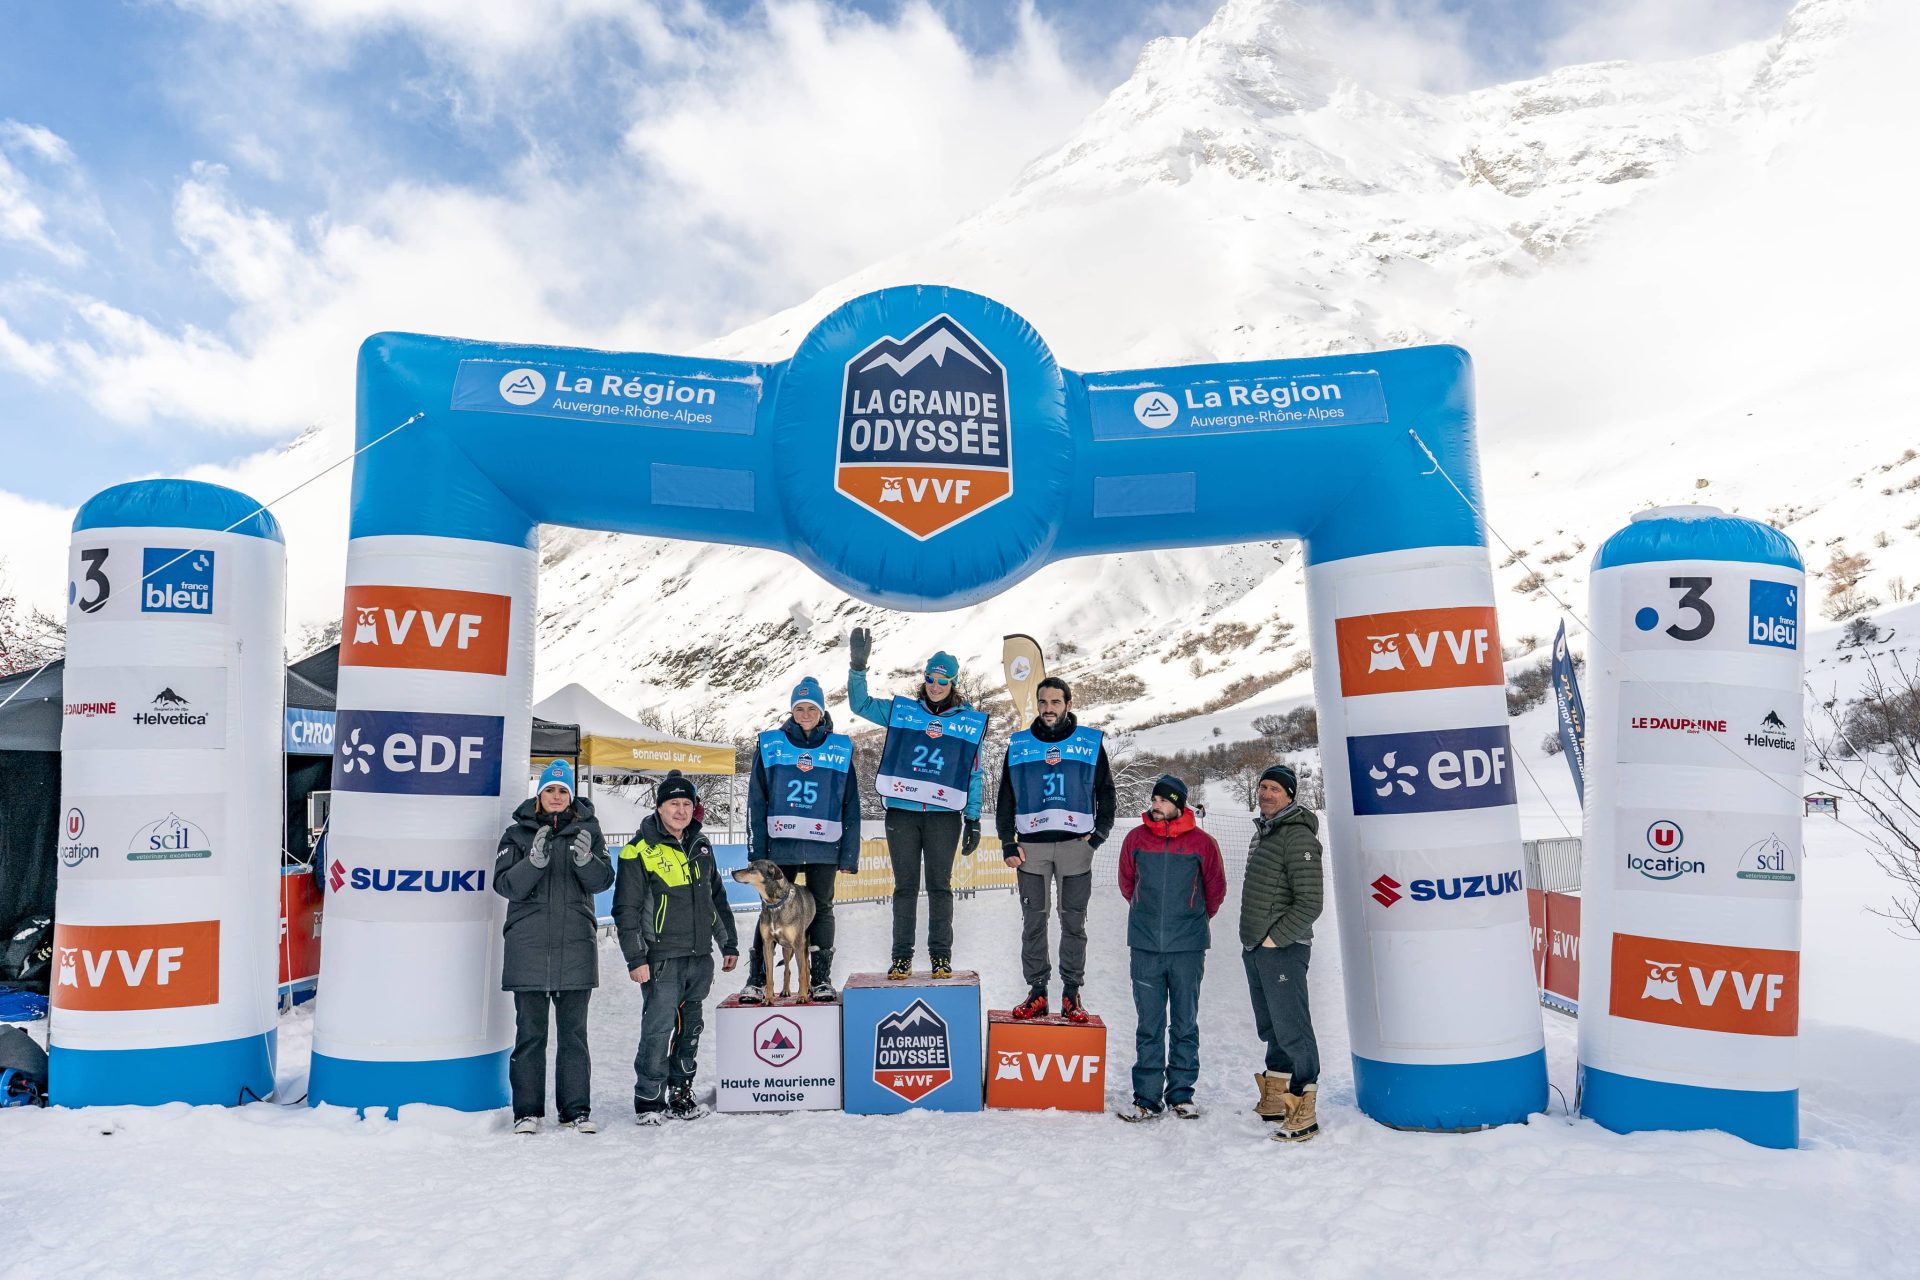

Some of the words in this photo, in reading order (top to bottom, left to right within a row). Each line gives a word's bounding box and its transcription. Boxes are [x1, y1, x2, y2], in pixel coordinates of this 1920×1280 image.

[555, 371, 592, 394] La
[602, 374, 716, 405] Région
[1185, 388, 1222, 409] La
[1229, 381, 1342, 409] Région
[553, 398, 712, 424] Auvergne-Rhône-Alpes
[852, 390, 884, 415] LA
[889, 389, 998, 418] GRANDE
[1190, 406, 1344, 428] Auvergne-Rhône-Alpes
[850, 417, 1000, 456] ODYSSÉE
[907, 477, 970, 504] VVF
[79, 548, 110, 613] 3
[181, 581, 209, 591] france
[146, 583, 208, 610] bleu
[1665, 577, 1715, 641] 3
[1779, 616, 1795, 626] france
[384, 608, 482, 650] VVF
[1753, 615, 1795, 645] bleu
[1406, 628, 1489, 668] VVF
[291, 720, 336, 744] CHRO
[958, 724, 977, 735] VVF
[1632, 717, 1648, 728] LE
[383, 733, 484, 774] eDF
[633, 748, 671, 761] Bonneval
[673, 753, 687, 762] sur
[688, 753, 702, 763] Arc
[827, 754, 845, 764] VVF
[912, 745, 944, 770] 24
[1075, 746, 1093, 756] VVF
[1428, 747, 1506, 790] eDF
[787, 780, 818, 804] 25
[1042, 773, 1064, 796] 31
[69, 817, 79, 833] U
[150, 828, 190, 850] scil
[1655, 829, 1674, 846] U
[60, 843, 99, 858] ocation
[1757, 849, 1785, 871] scil
[1627, 854, 1705, 873] location
[351, 867, 486, 893] SUZUKI
[1409, 869, 1523, 901] SUZUKI
[1562, 932, 1580, 961] VV
[82, 947, 184, 987] VVF
[1688, 967, 1784, 1012] VVF
[880, 1037, 894, 1048] LA
[896, 1036, 945, 1048] GRANDE
[879, 1048, 946, 1065] ODYSSÉE
[1027, 1053, 1100, 1083] VVF
[721, 1077, 760, 1089] Haute
[764, 1076, 836, 1088] Maurienne
[905, 1075, 934, 1086] VVF
[752, 1090, 805, 1102] Vanoise
